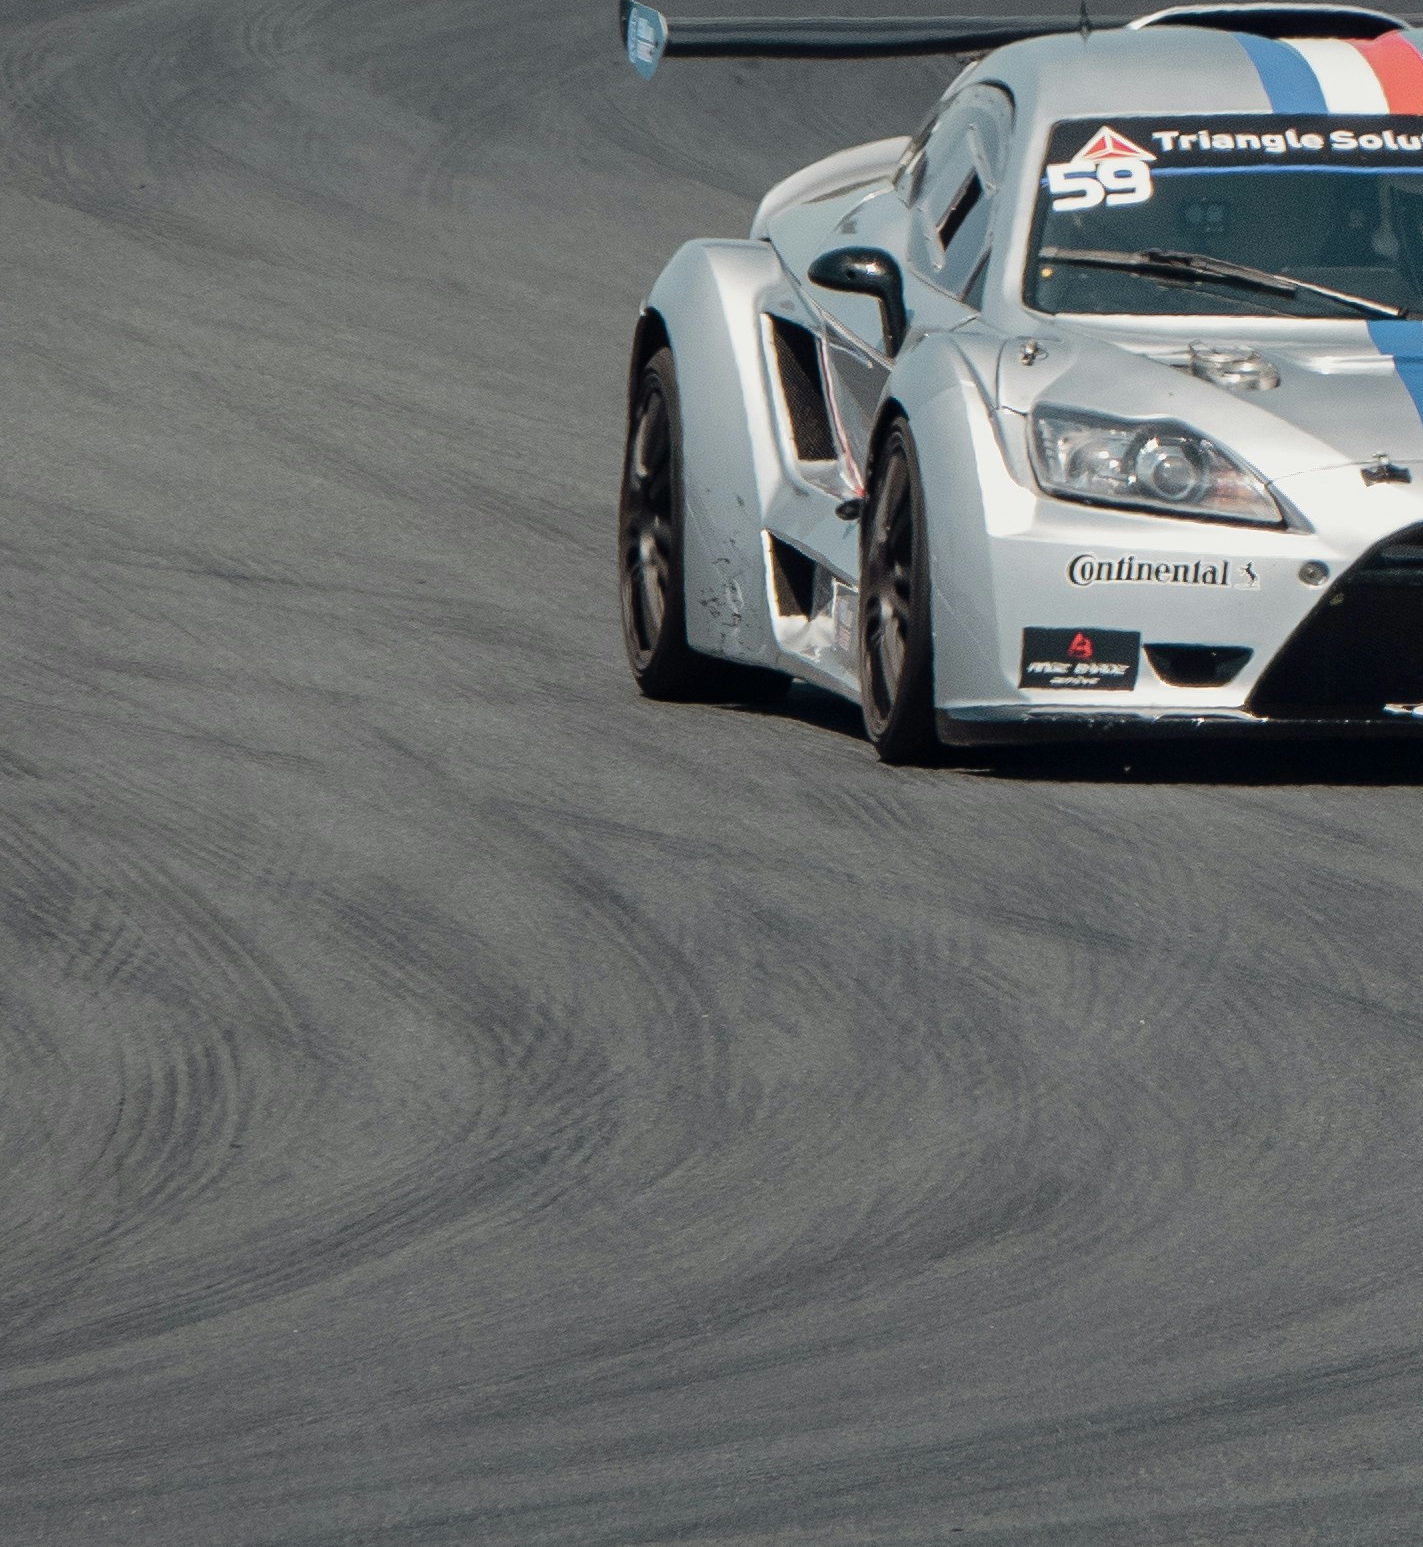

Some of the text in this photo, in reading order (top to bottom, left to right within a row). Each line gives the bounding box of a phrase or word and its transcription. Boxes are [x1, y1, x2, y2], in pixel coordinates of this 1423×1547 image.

[1152, 129, 1324, 154] Triangle
[1046, 159, 1153, 212] 59
[1068, 553, 1230, 586] Continental
